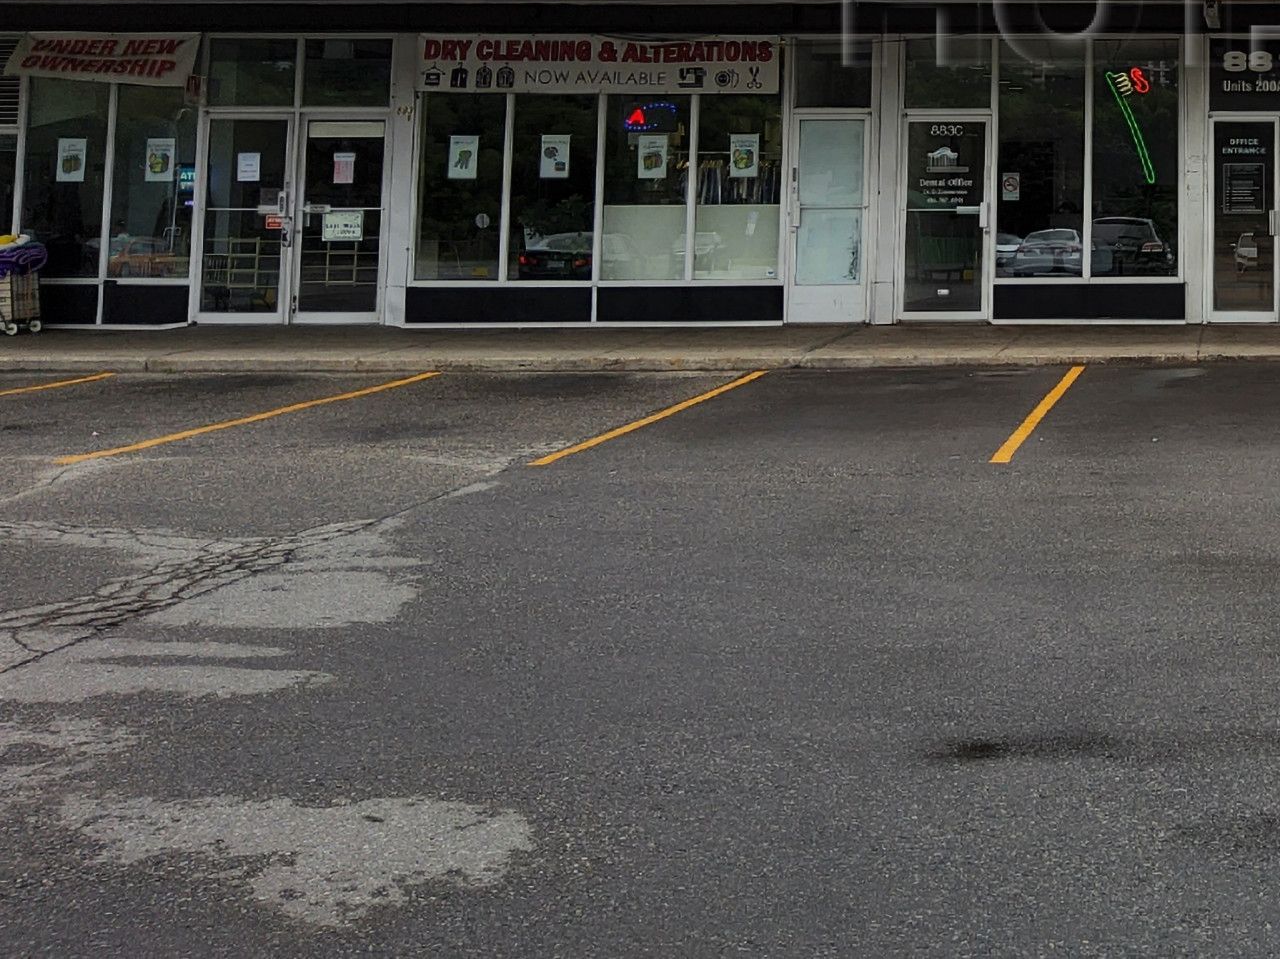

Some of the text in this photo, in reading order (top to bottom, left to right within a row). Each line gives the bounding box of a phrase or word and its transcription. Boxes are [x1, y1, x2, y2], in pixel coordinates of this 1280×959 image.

[30, 38, 186, 58] UNDER NEW
[423, 39, 774, 64] DRY CLEANING & ALTERATIONS
[20, 54, 178, 78] OWNERSHIP
[524, 70, 668, 87] NOW AVAILABLE
[1223, 79, 1253, 93] Units
[930, 124, 965, 138] 883C
[1229, 138, 1260, 146] OFFICE
[1221, 146, 1267, 155] ENTRANCE
[919, 177, 974, 189] Dental Office
